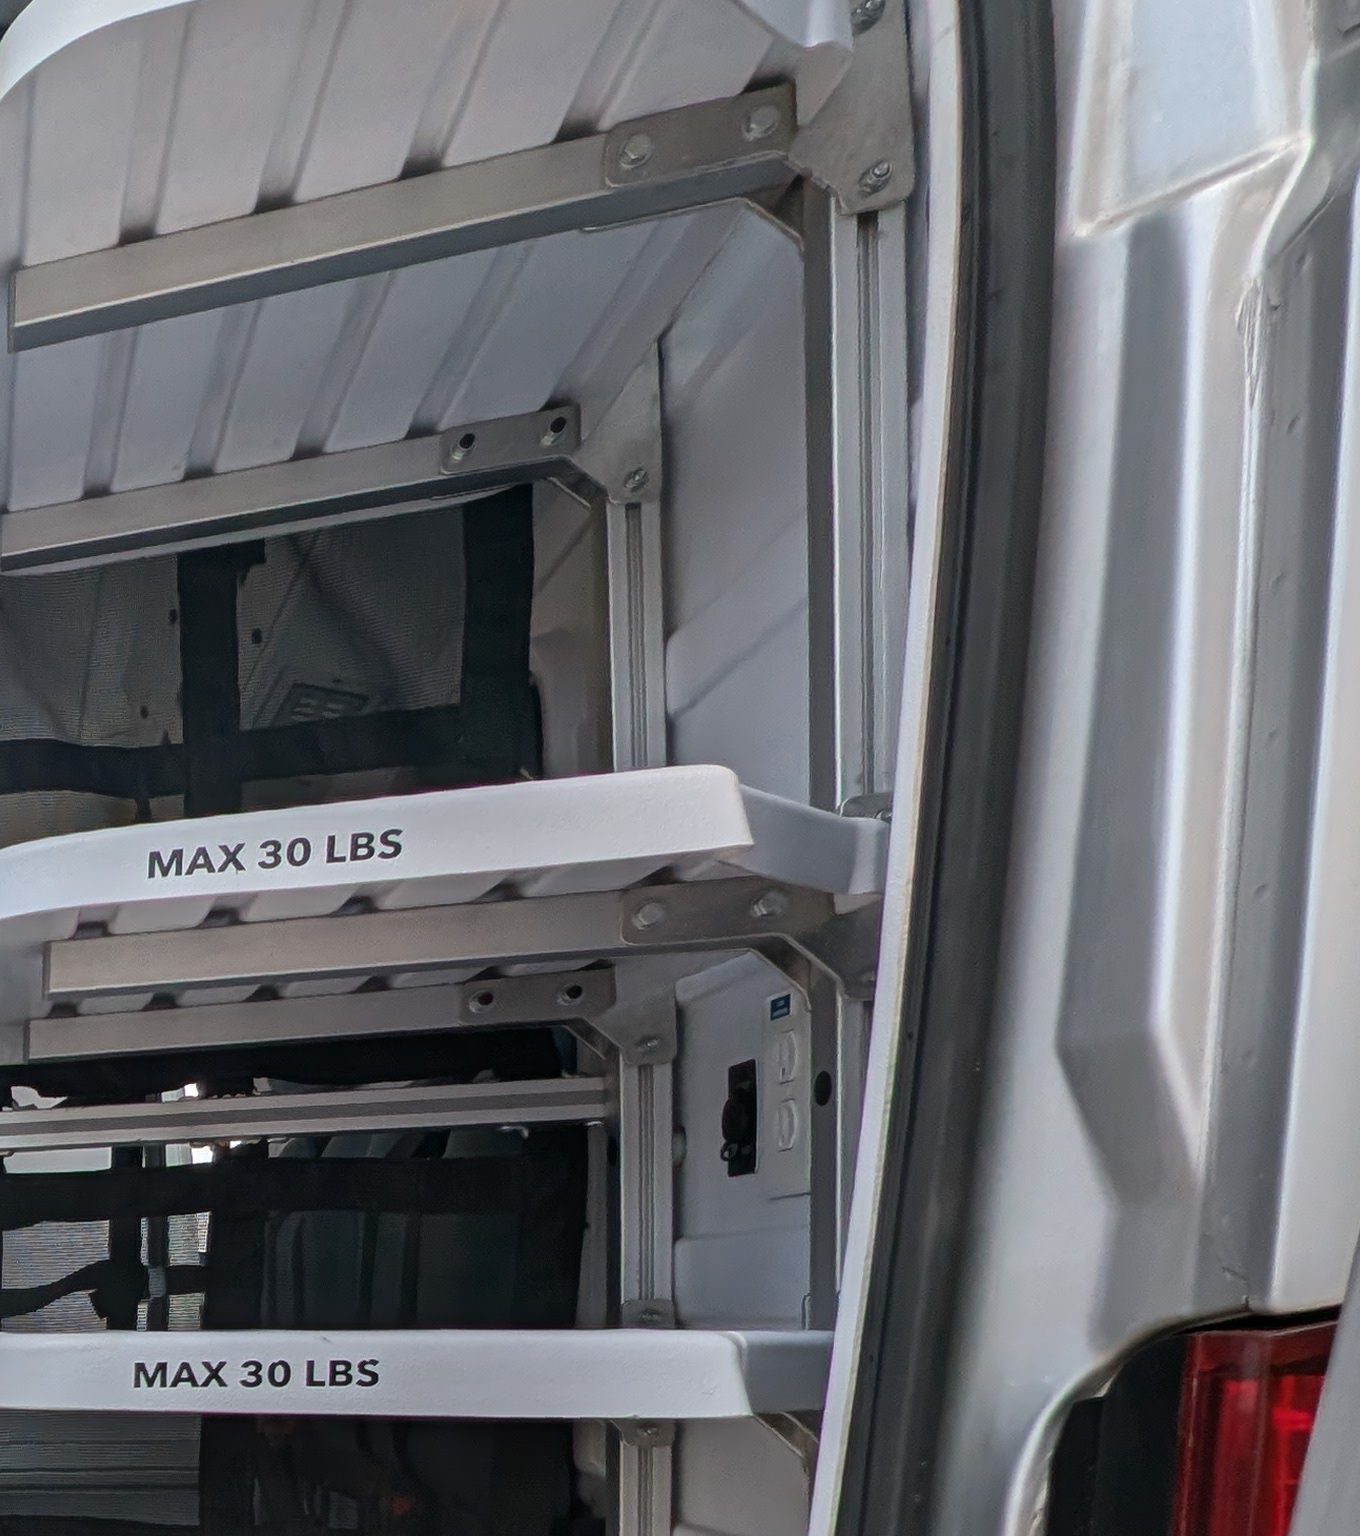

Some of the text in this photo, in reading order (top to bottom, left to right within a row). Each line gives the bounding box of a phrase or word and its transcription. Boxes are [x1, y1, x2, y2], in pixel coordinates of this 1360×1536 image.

[147, 828, 404, 879] MAX 30 LBS
[132, 1358, 380, 1389] MAX 30 LBS
